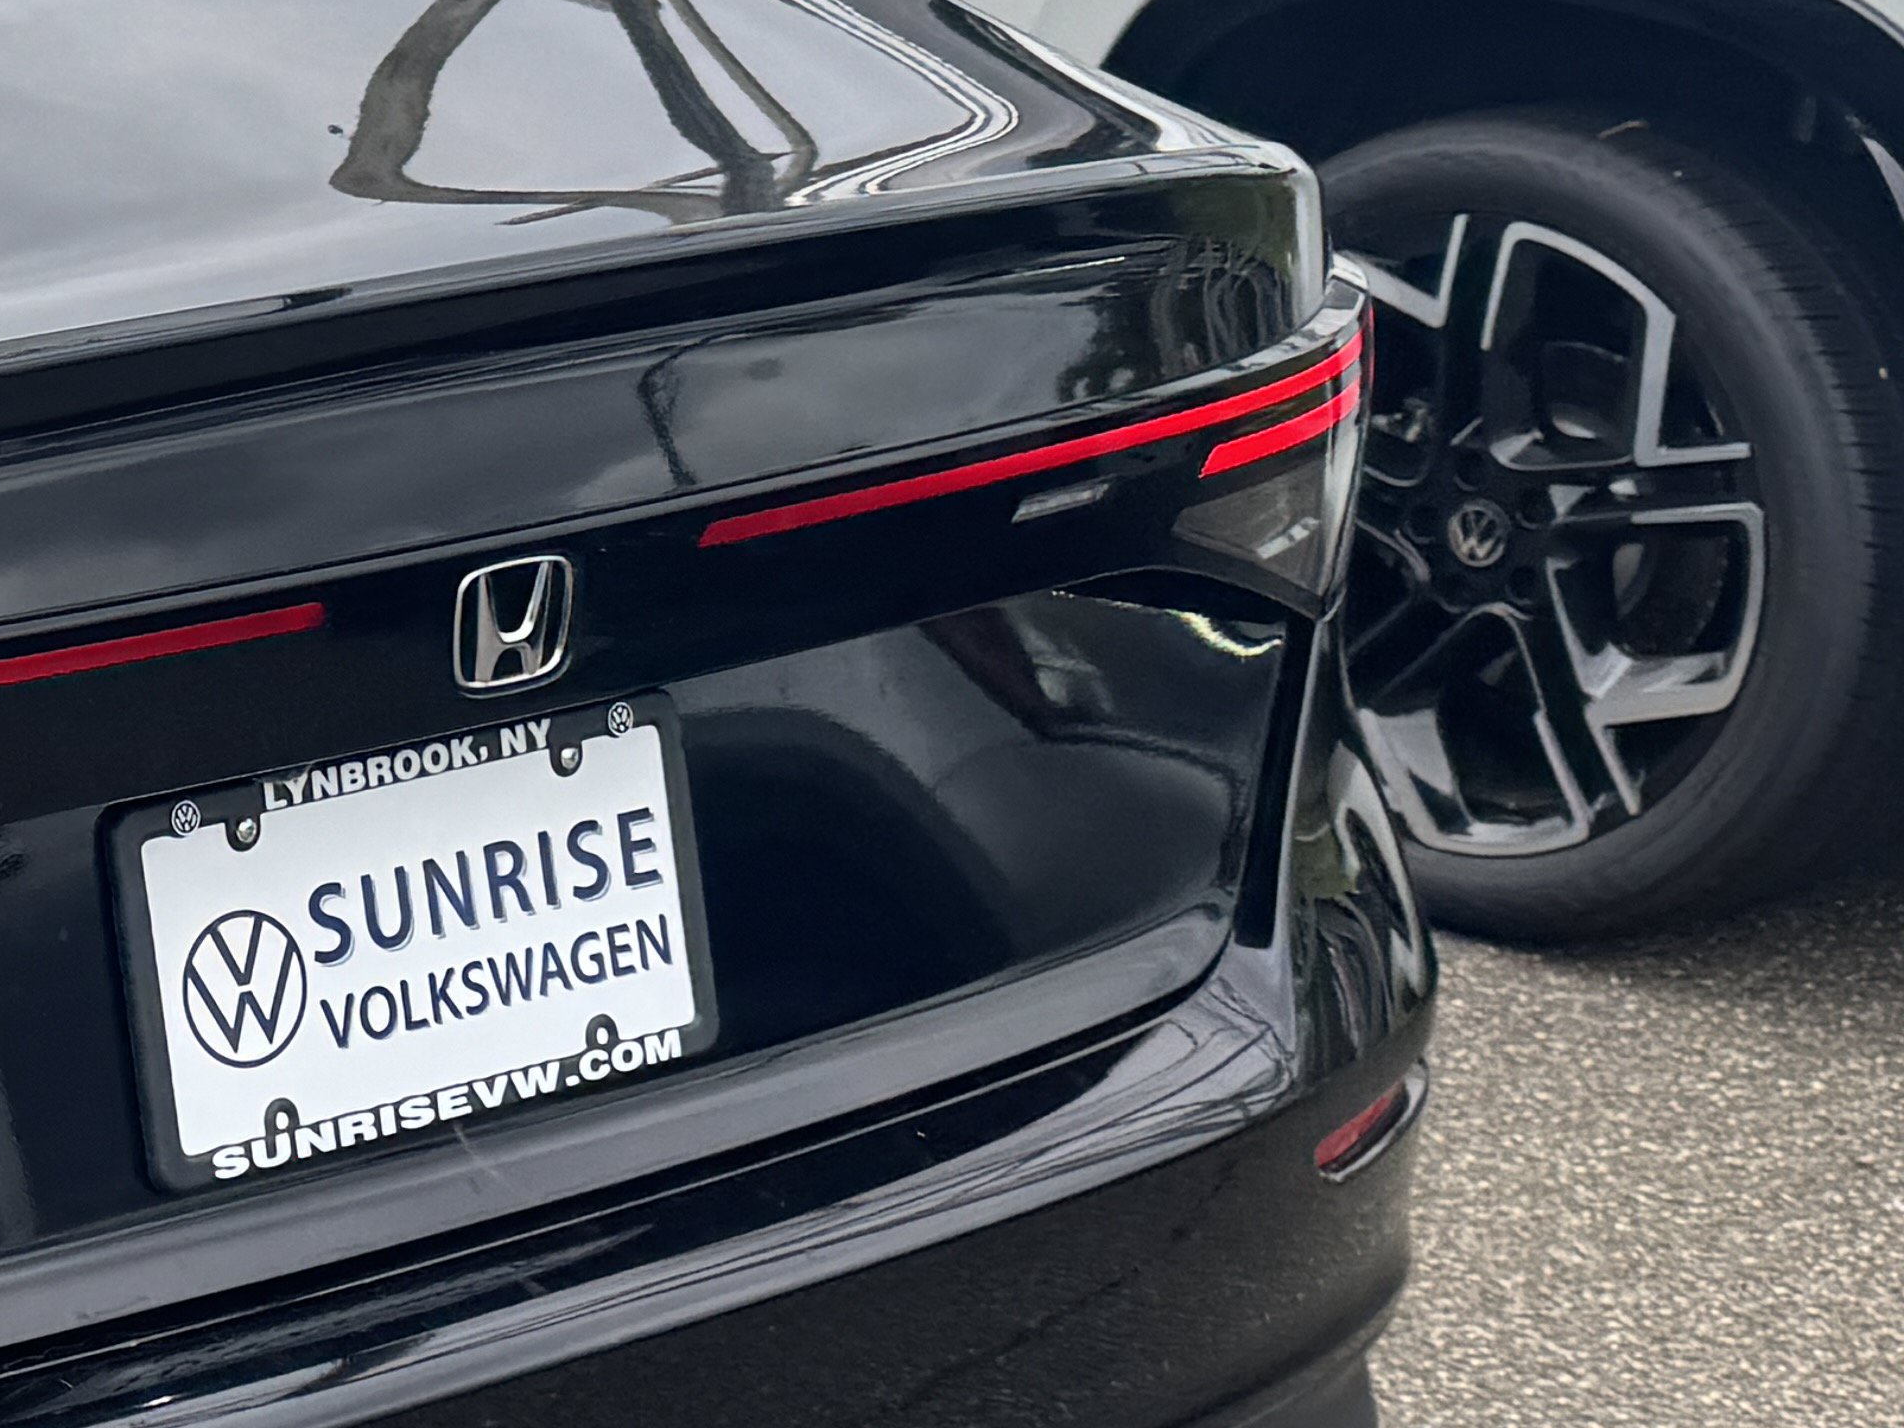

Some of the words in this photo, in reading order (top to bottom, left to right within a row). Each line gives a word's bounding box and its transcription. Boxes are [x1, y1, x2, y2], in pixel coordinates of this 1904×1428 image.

[262, 736, 489, 812] LYNBROOK,
[500, 718, 552, 757] NY
[307, 807, 663, 966] SUNRISE
[320, 914, 674, 1050] VOLKSWAGEN
[212, 1029, 682, 1179] SUNRISEVW.COM
